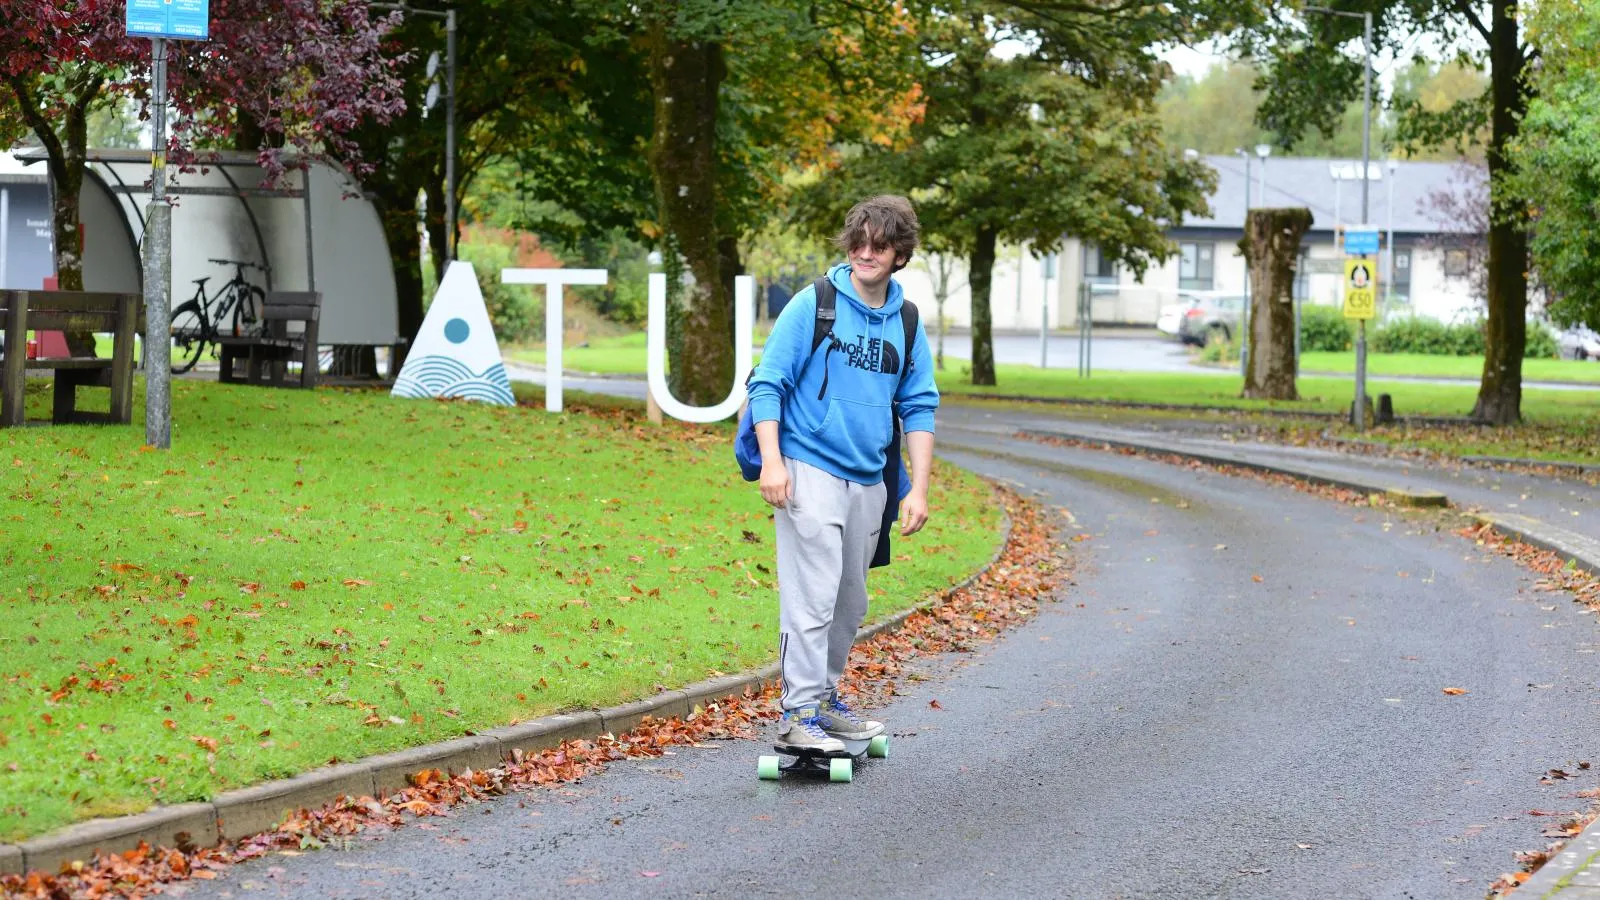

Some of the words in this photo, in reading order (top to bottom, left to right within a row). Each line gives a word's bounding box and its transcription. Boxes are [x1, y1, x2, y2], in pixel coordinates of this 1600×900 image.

[1349, 291, 1371, 308] €50
[390, 261, 752, 423] ATU
[857, 334, 881, 349] THE
[848, 355, 879, 372] FACE
